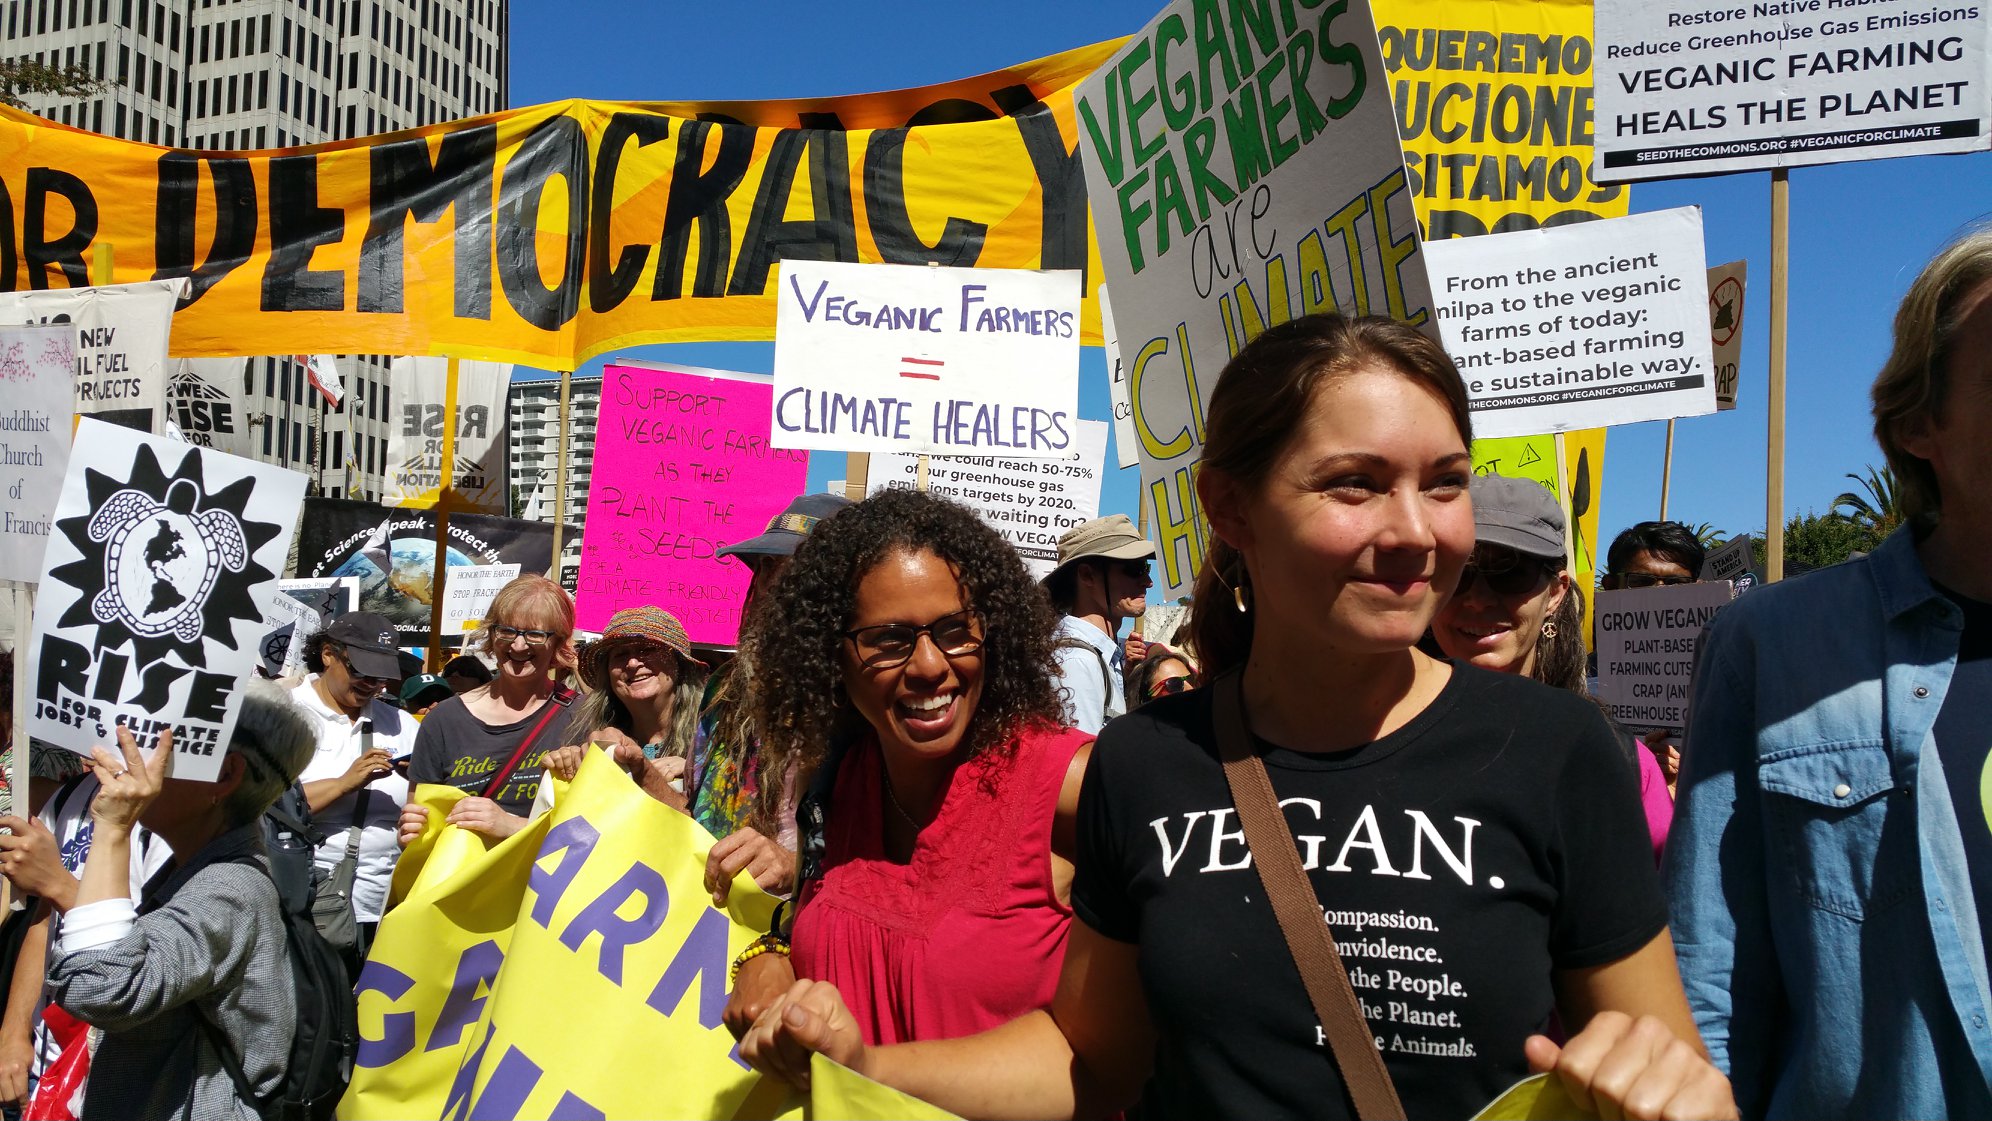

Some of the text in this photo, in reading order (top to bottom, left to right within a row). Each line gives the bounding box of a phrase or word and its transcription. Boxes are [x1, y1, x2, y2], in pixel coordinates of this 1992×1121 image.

[1607, 6, 1980, 59] Reduce Greenhouse Gas Emissions
[1668, 7, 1747, 28] Restore
[1618, 36, 1965, 95] VEGANIC FARMING
[1078, 0, 1325, 188] VEGAN
[1616, 81, 1969, 137] HEALS THE PLANET
[1117, 0, 1367, 275] FARMERS
[1636, 125, 1941, 163] SEEDTHECOMMONS.ORG #VEGANICFORCLIMATE
[0, 83, 1091, 331] R DEMOCRACY
[1192, 184, 1276, 299] are
[1446, 252, 1658, 293] From the ancient
[790, 273, 1074, 338] VEGANIC FARMERS
[1503, 296, 1526, 313] to
[1533, 290, 1575, 309] the
[1581, 274, 1682, 303] veganic
[80, 328, 115, 348] NEW
[1461, 306, 1648, 343] farms of today:
[97, 353, 128, 373] FUEL
[1449, 330, 1685, 369] ant-based farming
[1491, 361, 1634, 391] sustainable
[1641, 355, 1701, 375] way.
[173, 382, 203, 398] WE
[616, 374, 728, 417] SUPPORT
[1562, 380, 1676, 400] #VEGANICFORCLIMATE
[0, 410, 50, 432] uddhist
[621, 416, 715, 450] VEGANIC
[776, 386, 1070, 450] CLIMATE HEALERS
[654, 460, 735, 484] AS THEY
[905, 463, 919, 474] of
[951, 469, 1035, 491] greenhouse
[1039, 481, 1064, 494] gas
[998, 459, 1037, 473] reach
[1042, 463, 1093, 479] 50-75%
[9, 478, 24, 499] of
[888, 477, 1076, 510] emiions targets by 2020.
[601, 487, 734, 526] PLANT THE
[986, 508, 1049, 528] waiting
[324, 527, 377, 562] Science
[389, 517, 427, 534] peak
[447, 522, 488, 552] rotect
[1015, 548, 1060, 559] FORCLIMAT
[1016, 530, 1060, 546] VEGA
[473, 588, 501, 598] FRACKI
[581, 577, 652, 596] CLIMATE
[1602, 606, 1722, 631] GROW VEGANI
[1625, 638, 1696, 654] PLANT-BASE
[36, 632, 239, 724] RISE
[1611, 662, 1660, 676] FARMING
[1633, 684, 1688, 702] CRAP (AN
[61, 696, 221, 742] FOR CLIMATE
[1607, 704, 1679, 721] REENHOUSE
[35, 702, 85, 730] JOBS
[115, 733, 216, 757] USTICE
[1318, 905, 1440, 932] ompassion.
[1350, 966, 1468, 1001] the People.
[1359, 998, 1462, 1028] he Planet.
[1391, 1033, 1477, 1057] Animals.
